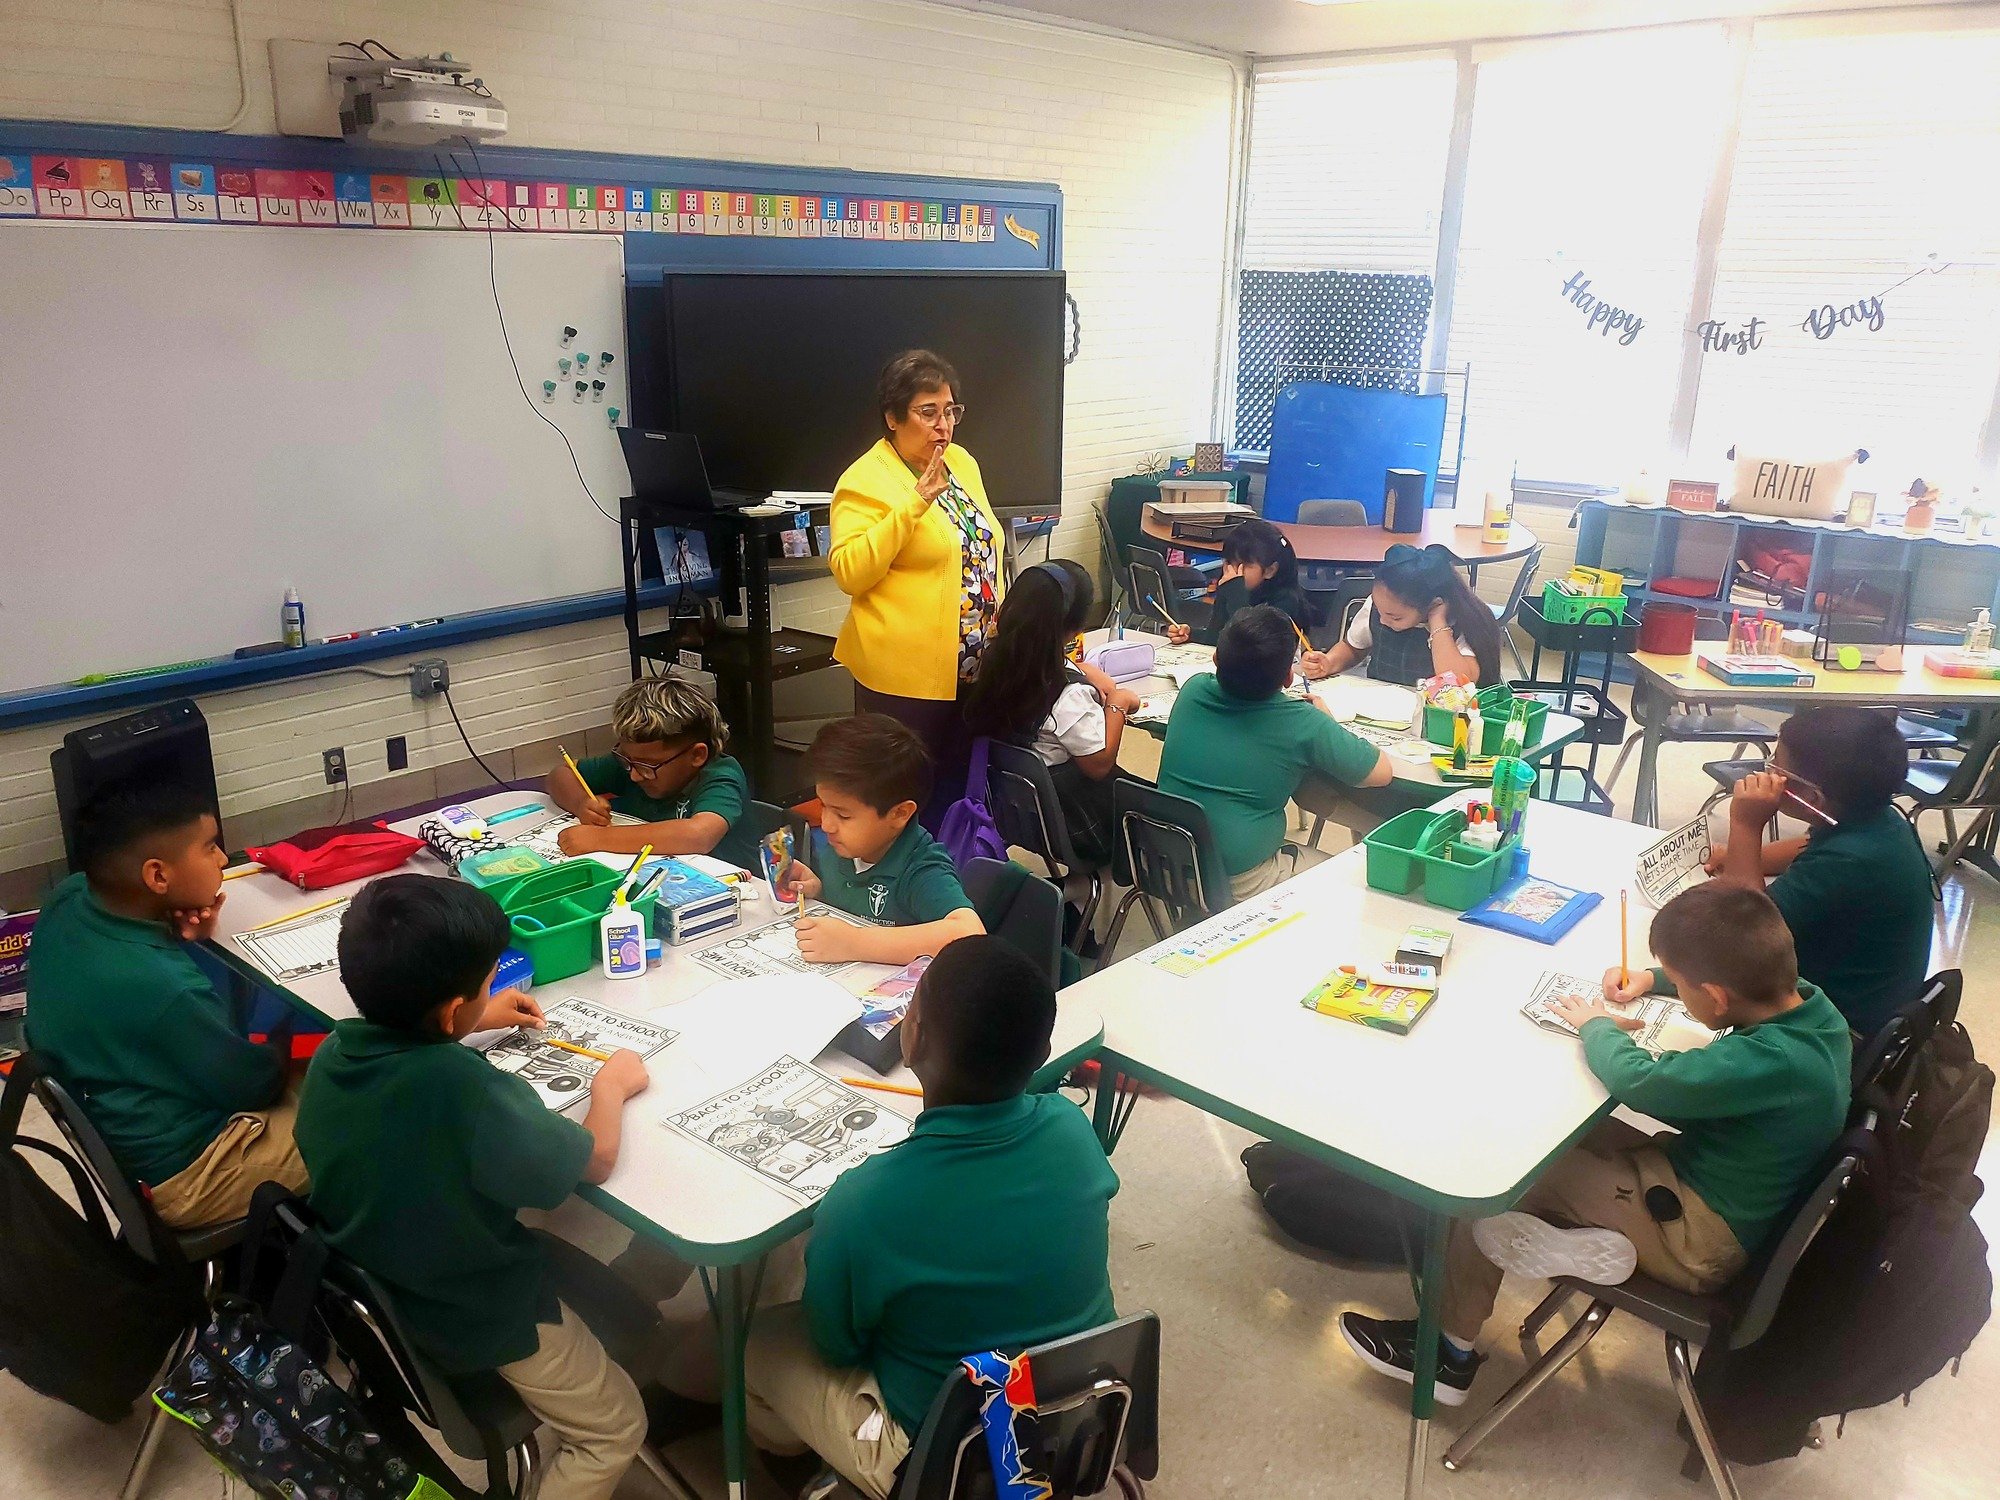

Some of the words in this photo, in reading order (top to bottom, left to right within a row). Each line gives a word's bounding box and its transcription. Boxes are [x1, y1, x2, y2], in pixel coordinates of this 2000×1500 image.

[458, 109, 476, 118] EPSON
[49, 188, 72, 216] Pp
[91, 190, 126, 217] Qq
[143, 192, 165, 211] Rr
[187, 194, 205, 212] Ss
[265, 197, 291, 216] Uu
[308, 198, 327, 217] Vv
[341, 200, 367, 218] Ww
[382, 202, 400, 219] Xx
[426, 203, 442, 227] Yy
[518, 207, 527, 223] 0
[550, 209, 557, 224] 1
[578, 209, 587, 224] 2
[608, 210, 616, 225] 3
[634, 211, 643, 226] 4
[661, 213, 669, 227] 5
[688, 213, 696, 227] 6
[713, 215, 720, 228] 7
[737, 215, 744, 229] 8
[761, 217, 768, 230] 9
[781, 217, 793, 231] 10
[804, 219, 814, 232] 11
[826, 219, 838, 233] 12
[848, 220, 859, 233] 13
[868, 221, 878, 234] 14
[889, 222, 899, 235] 15
[908, 222, 918, 235] 16
[927, 223, 937, 236] 17
[946, 223, 956, 236] 18
[964, 224, 974, 237] 19
[981, 225, 992, 237] 20
[1561, 269, 1645, 346] Happy
[1697, 317, 1766, 355] First
[1802, 295, 1885, 340] Day
[1753, 461, 1816, 503] FAITH
[669, 570, 709, 582] SNWMAN
[682, 563, 708, 572] GVING
[1642, 854, 1659, 872] ALL
[1659, 834, 1685, 861] ABOUT
[1687, 824, 1702, 842] ME
[1644, 866, 1661, 885] LET'S
[1660, 852, 1682, 873] SHARE
[608, 927, 631, 936] School
[1193, 933, 1224, 948] Jesus
[1223, 911, 1267, 932] Gonzalez
[708, 951, 725, 966] ME
[720, 959, 762, 977] ABOUT
[552, 1008, 594, 1027] WELCOME
[571, 1003, 602, 1019] BACK
[601, 1016, 617, 1025] TO
[617, 1021, 661, 1038] SCHOOL
[567, 1060, 596, 1074] SCHOOL
[688, 1102, 723, 1121] BACK
[722, 1094, 740, 1104] TO
[740, 1068, 788, 1096] SCHOOL
[693, 1107, 742, 1132] WELCOME
[784, 1068, 807, 1085] YEAR
[811, 1103, 844, 1121] SCHOOL
[822, 1144, 858, 1164] BELONGS
[856, 1137, 868, 1145] TO
